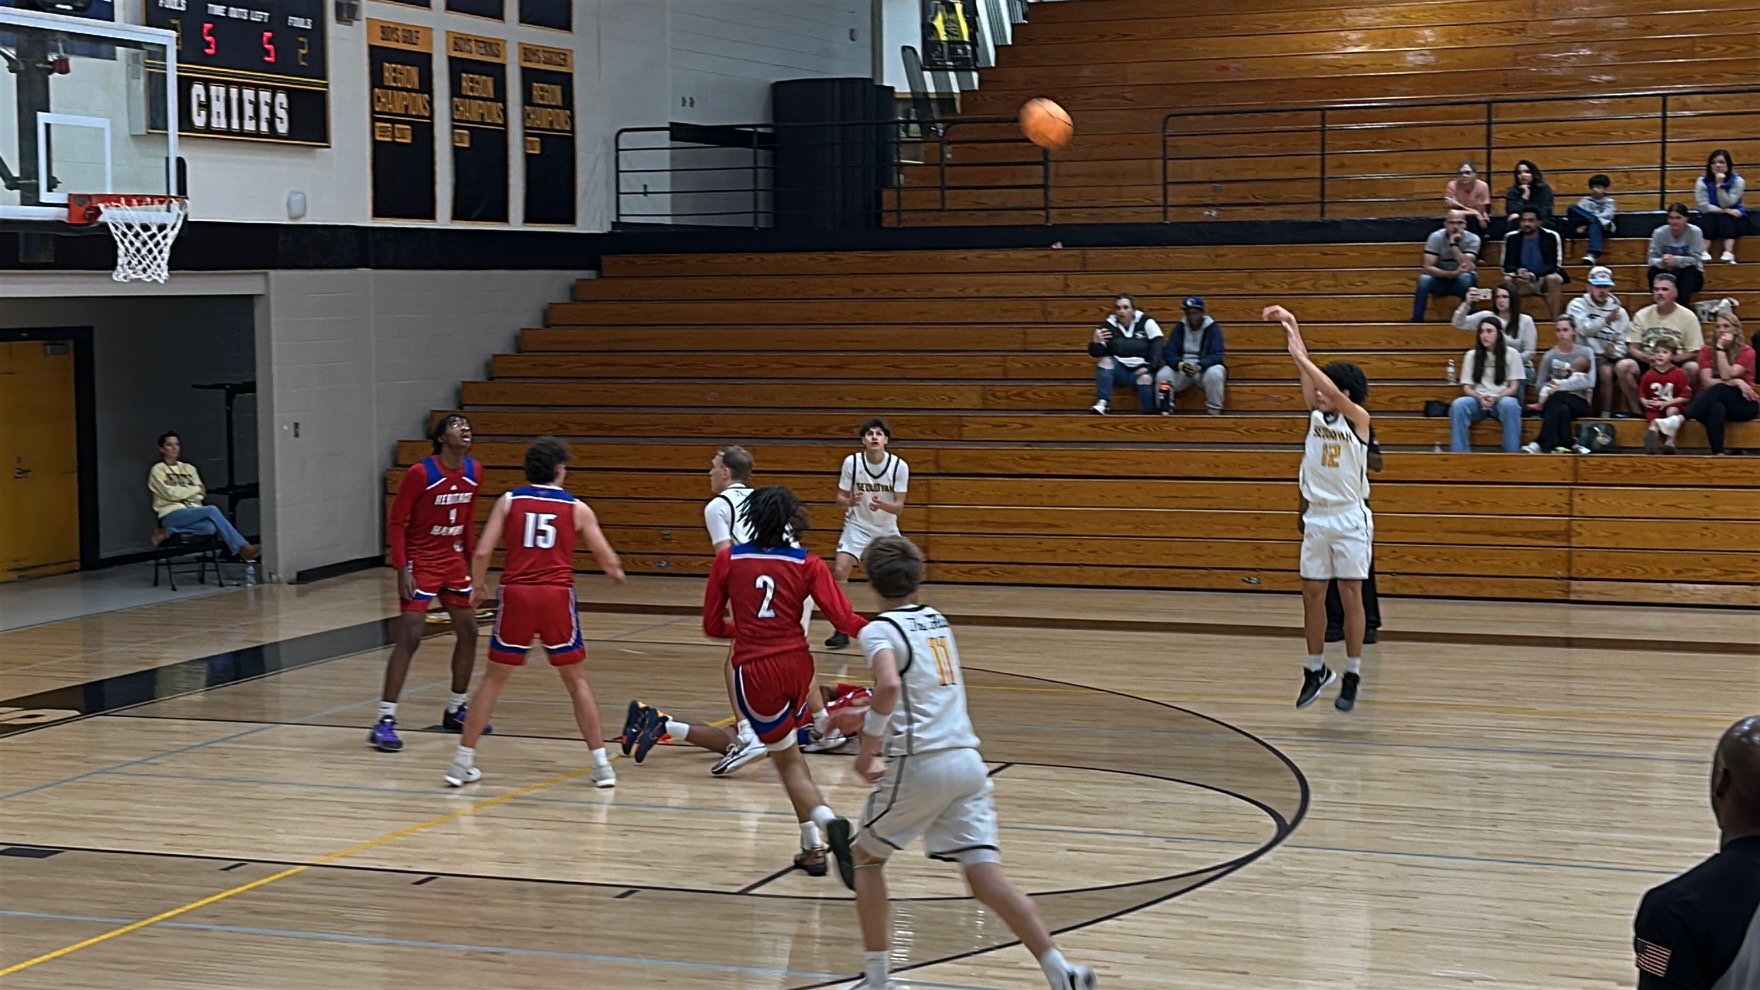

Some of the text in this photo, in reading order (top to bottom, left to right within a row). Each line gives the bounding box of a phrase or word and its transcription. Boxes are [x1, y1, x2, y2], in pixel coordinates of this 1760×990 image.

[207, 3, 227, 16] TIME
[250, 10, 270, 22] LEFT
[288, 16, 313, 29] FOULS
[203, 23, 217, 56] 5
[263, 31, 277, 63] 5
[297, 37, 309, 66] 2
[401, 28, 420, 45] GOLF
[383, 62, 420, 90] REGION
[461, 73, 495, 98] REGION
[373, 87, 431, 116] CHAMPIONS
[532, 82, 562, 106] REGION
[191, 81, 289, 136] CHIEFS
[453, 97, 504, 124] CHAMPIONS
[525, 105, 571, 131] CHAMPIONS
[1321, 442, 1341, 468] 12
[523, 512, 558, 549] 15
[755, 575, 775, 618] 2
[928, 636, 957, 687] 11
